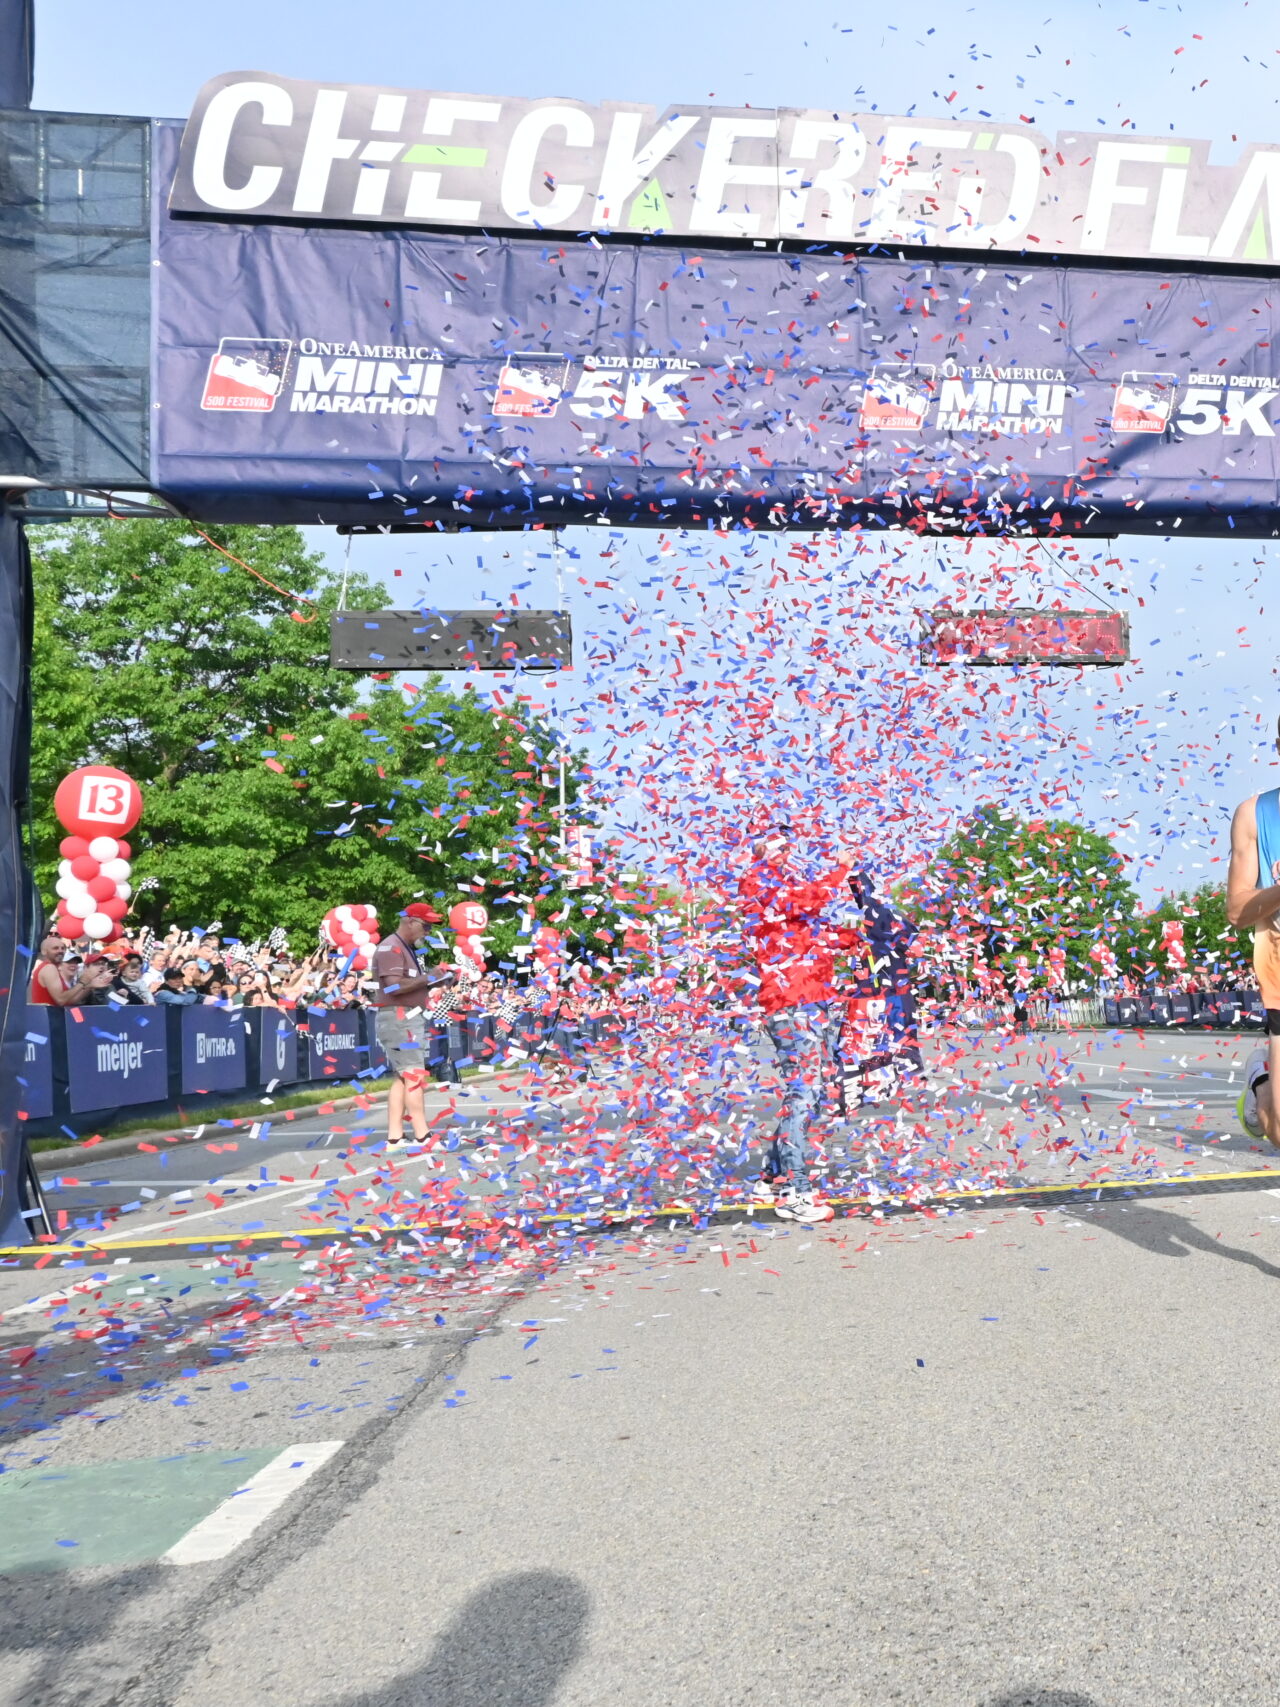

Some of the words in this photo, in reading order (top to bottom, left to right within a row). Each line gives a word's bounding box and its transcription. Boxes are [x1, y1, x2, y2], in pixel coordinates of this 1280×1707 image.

[192, 81, 1041, 244] CHECKERED
[294, 356, 444, 396] MINI
[1188, 374, 1227, 386] DELTA
[1229, 375, 1280, 389] DENTAL
[205, 395, 225, 407] 500
[226, 396, 271, 408] FESTIVAL
[290, 392, 437, 416] MARATHON
[569, 371, 690, 420] 5K
[939, 380, 1067, 416] MINI
[881, 416, 920, 427] FESTIVAL
[936, 412, 1063, 434] MARATHON
[1176, 388, 1279, 437] 5K
[1130, 420, 1163, 430] FESTIVAL
[86, 784, 125, 816] 13
[206, 1037, 227, 1058] WTHR
[324, 1033, 355, 1051] ENDURANCE
[97, 1032, 143, 1079] meijer
